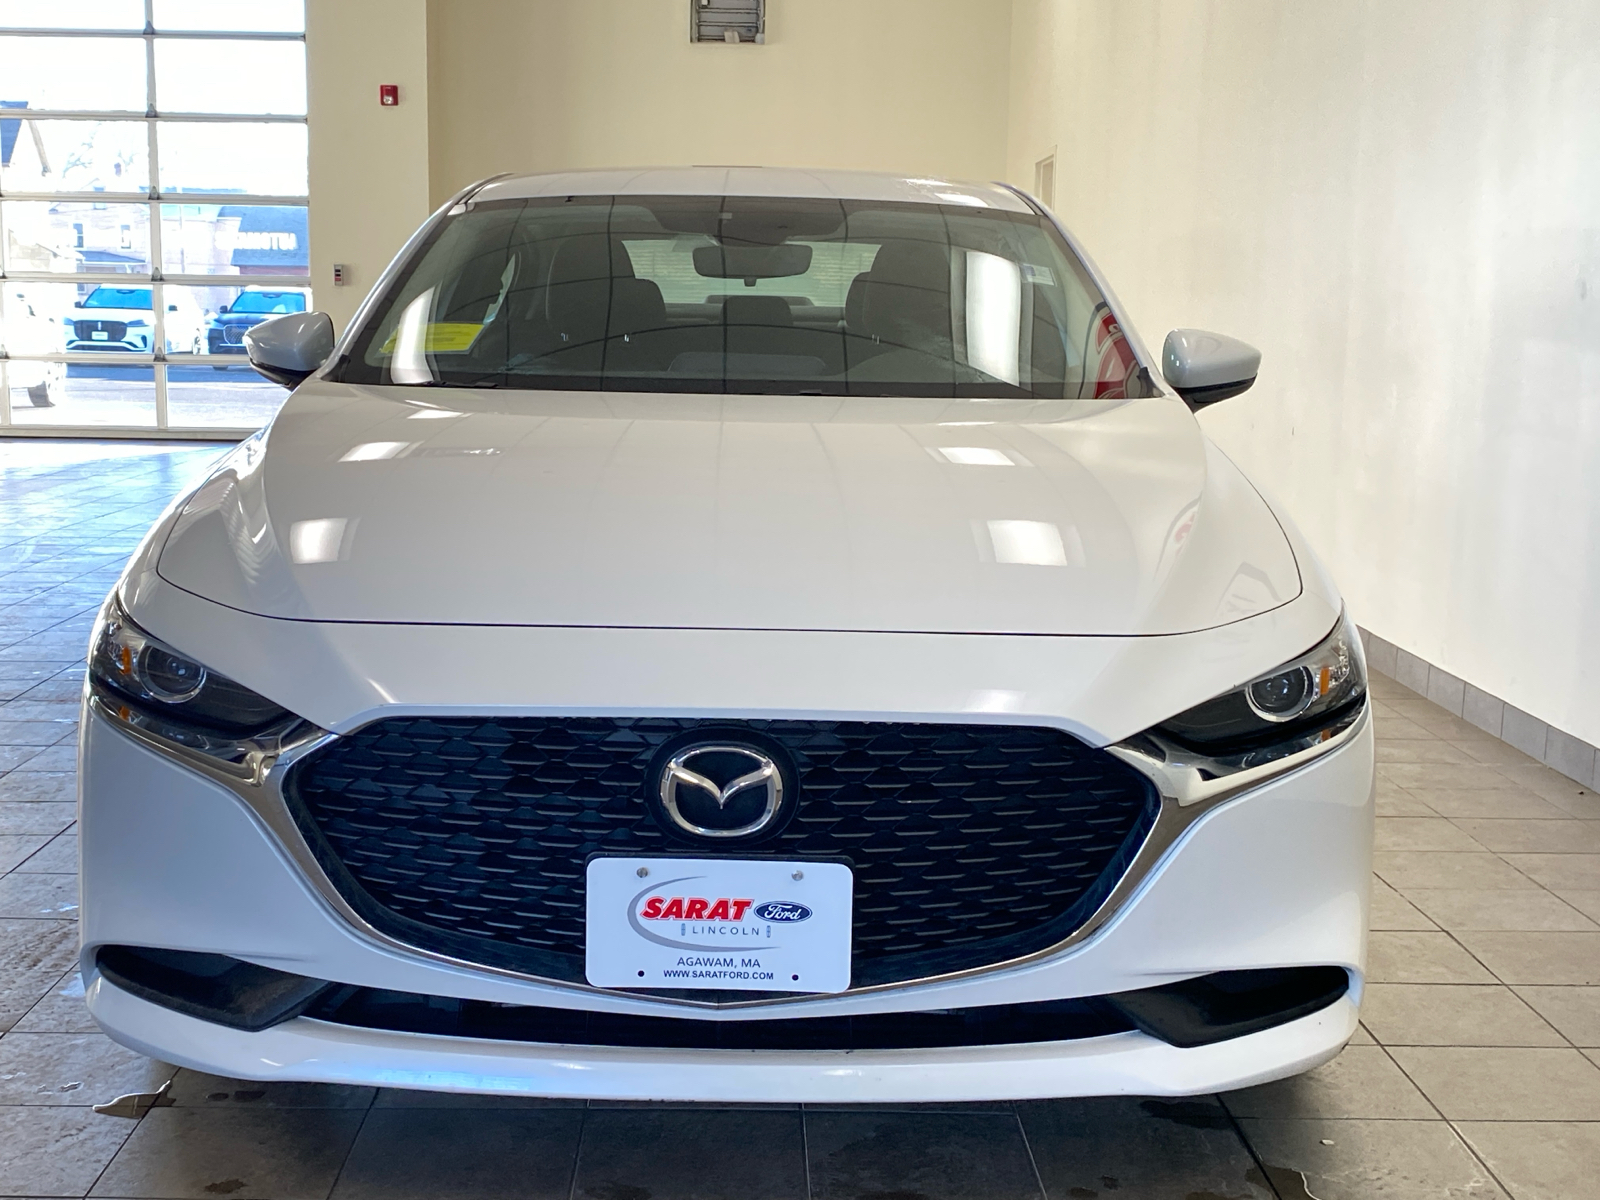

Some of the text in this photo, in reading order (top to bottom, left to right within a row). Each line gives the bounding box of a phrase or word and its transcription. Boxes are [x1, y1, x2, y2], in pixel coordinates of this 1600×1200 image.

[640, 896, 803, 922] SARAT Ford
[692, 926, 760, 936] LINCOLN
[677, 957, 761, 969] AGAWAM, MA
[663, 970, 774, 980] WWW.SARATFORD.COM
